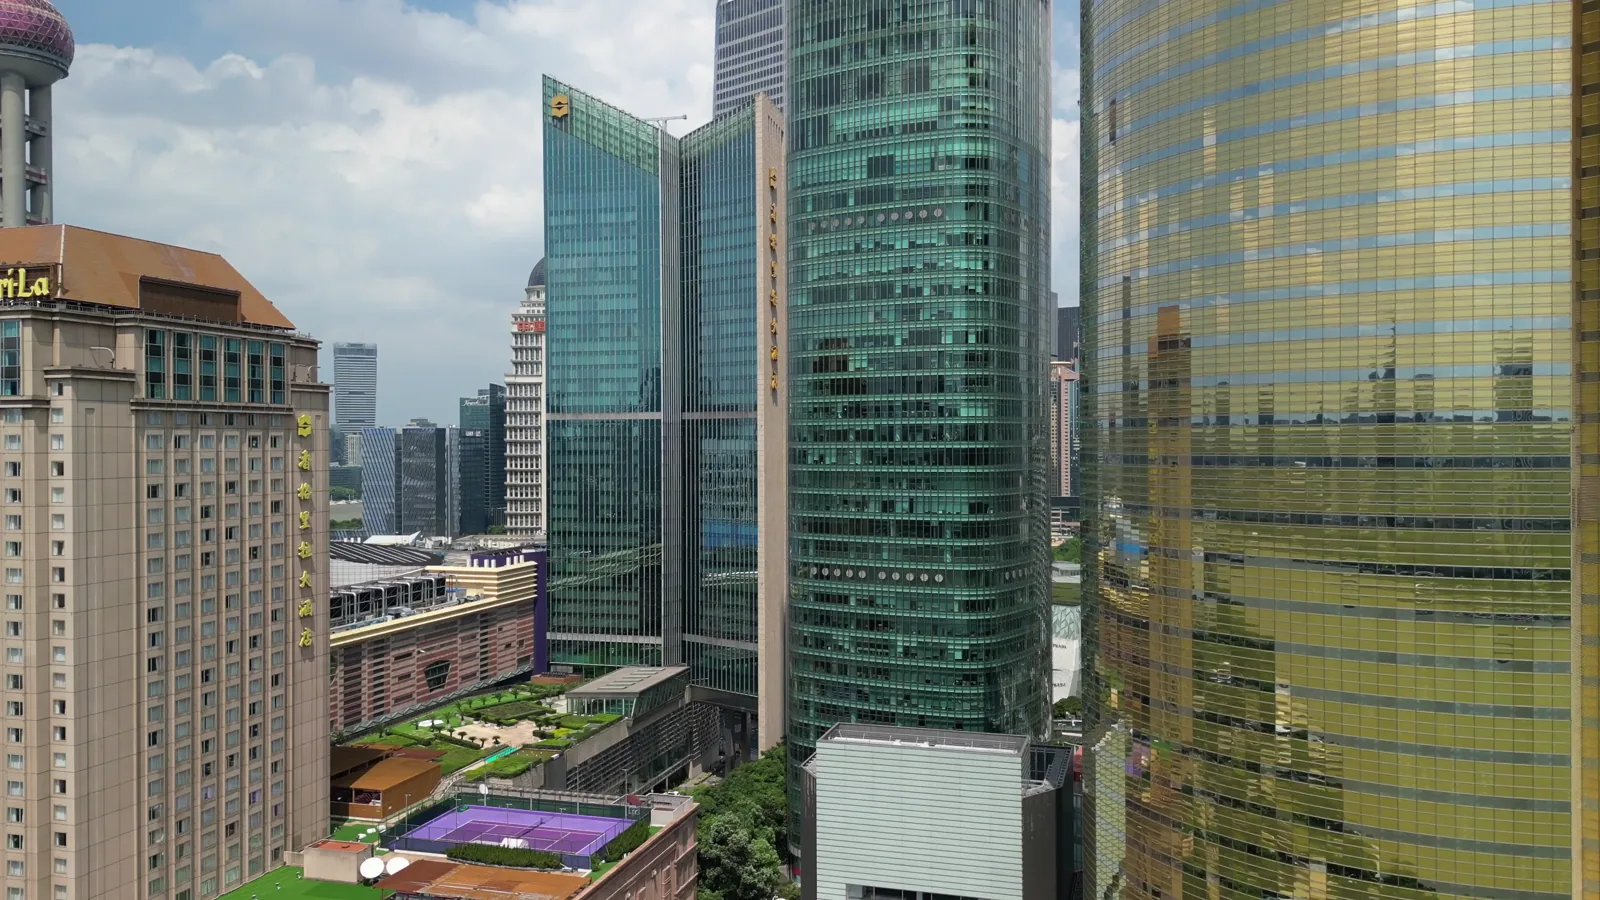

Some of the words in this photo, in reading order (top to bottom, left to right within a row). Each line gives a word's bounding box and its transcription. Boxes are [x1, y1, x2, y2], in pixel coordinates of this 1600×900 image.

[297, 449, 312, 648] 香格里拉大酒店
